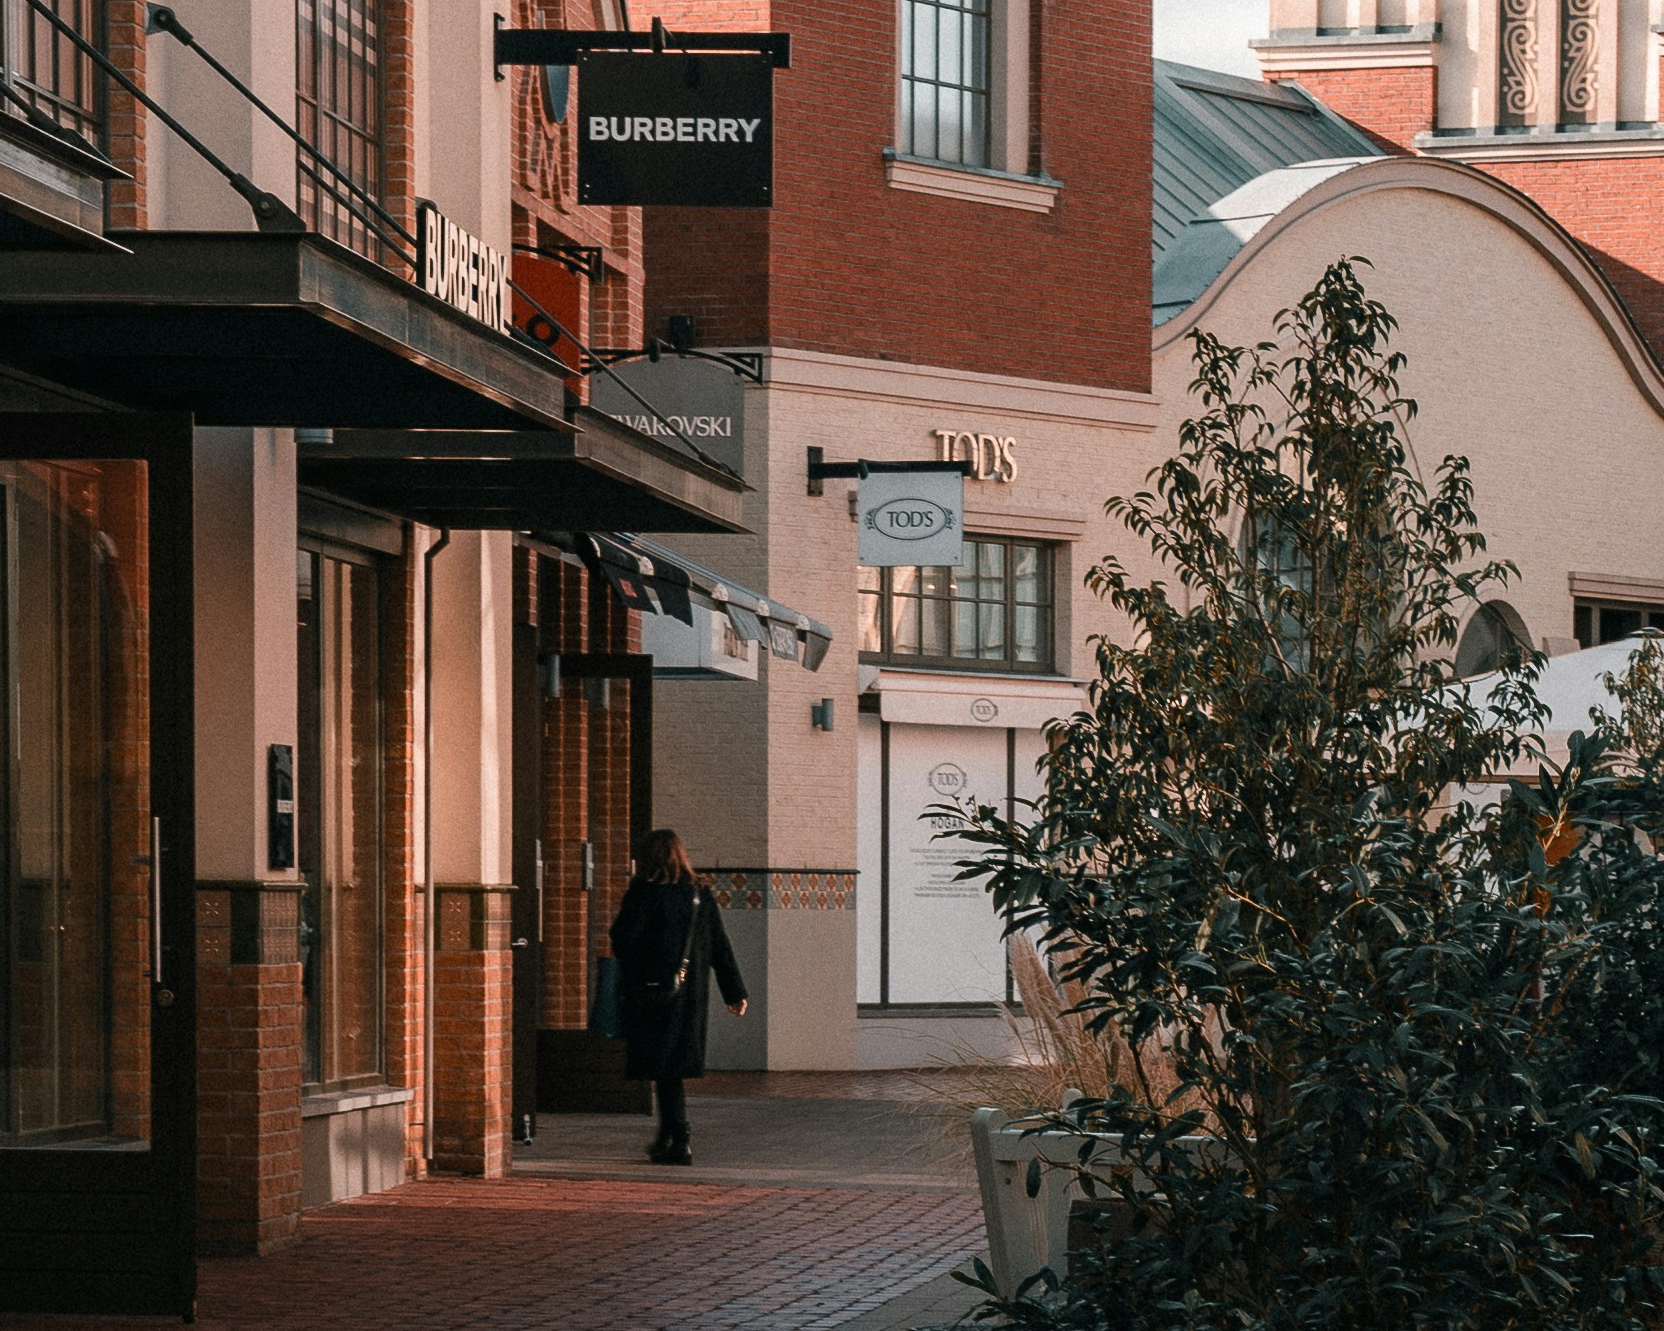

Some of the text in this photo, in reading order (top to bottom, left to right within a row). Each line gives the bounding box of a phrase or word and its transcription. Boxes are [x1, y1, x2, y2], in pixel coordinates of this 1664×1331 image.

[589, 116, 761, 143] BURBERRY
[425, 208, 511, 337] BURBERRY
[609, 414, 732, 437] WAROVSKI
[932, 429, 1018, 484] TOD'S
[887, 511, 934, 528] TOD'S
[930, 816, 965, 829] HOGAN
